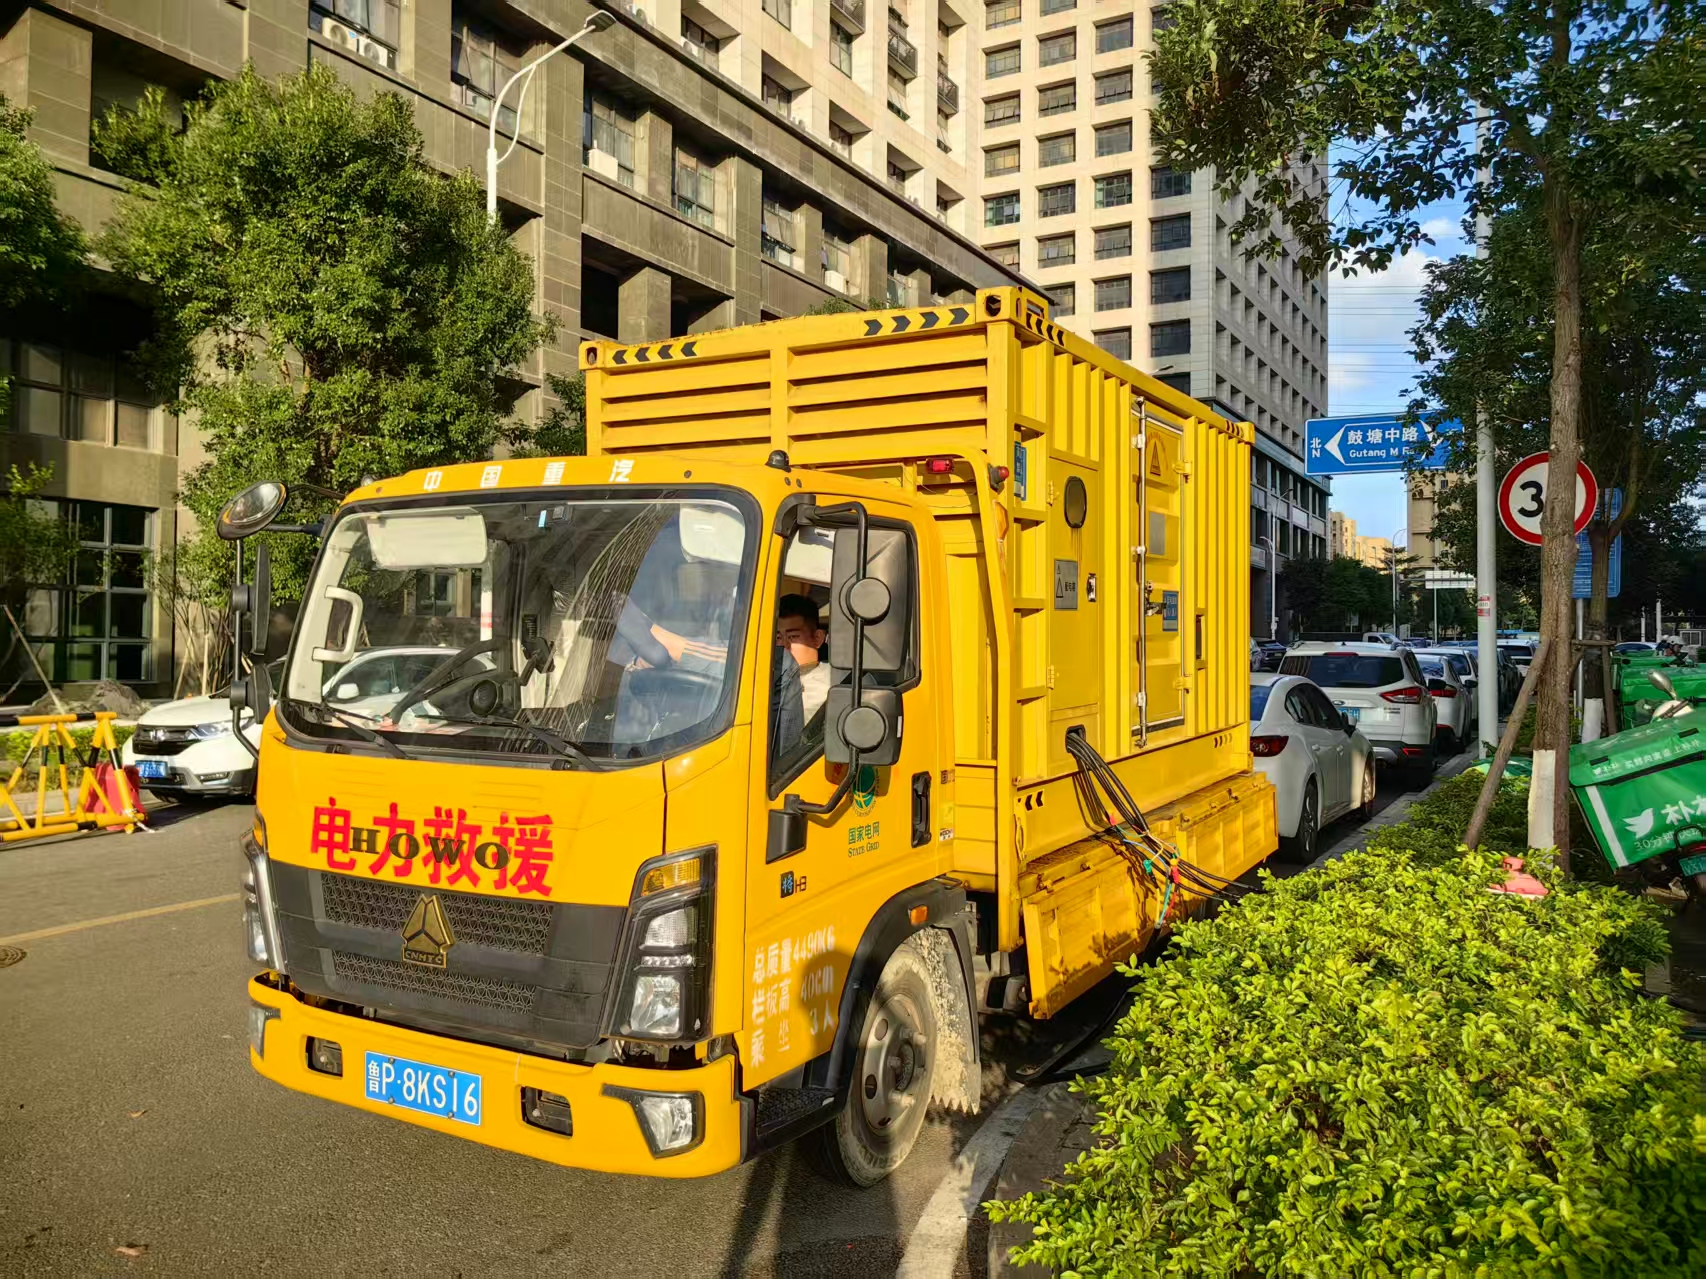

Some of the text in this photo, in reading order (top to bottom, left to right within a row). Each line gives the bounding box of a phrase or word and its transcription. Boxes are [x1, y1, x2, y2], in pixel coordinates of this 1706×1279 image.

[1310, 437, 1322, 449] 北
[1347, 427, 1419, 445] 鼓塘中路
[1311, 448, 1321, 458] N
[1349, 449, 1386, 458] Gutang
[1390, 447, 1399, 456] M
[423, 459, 635, 491] 中国重汽
[848, 821, 880, 845] 国家电网
[310, 796, 554, 897] 电力救援
[350, 826, 510, 870] HOWO
